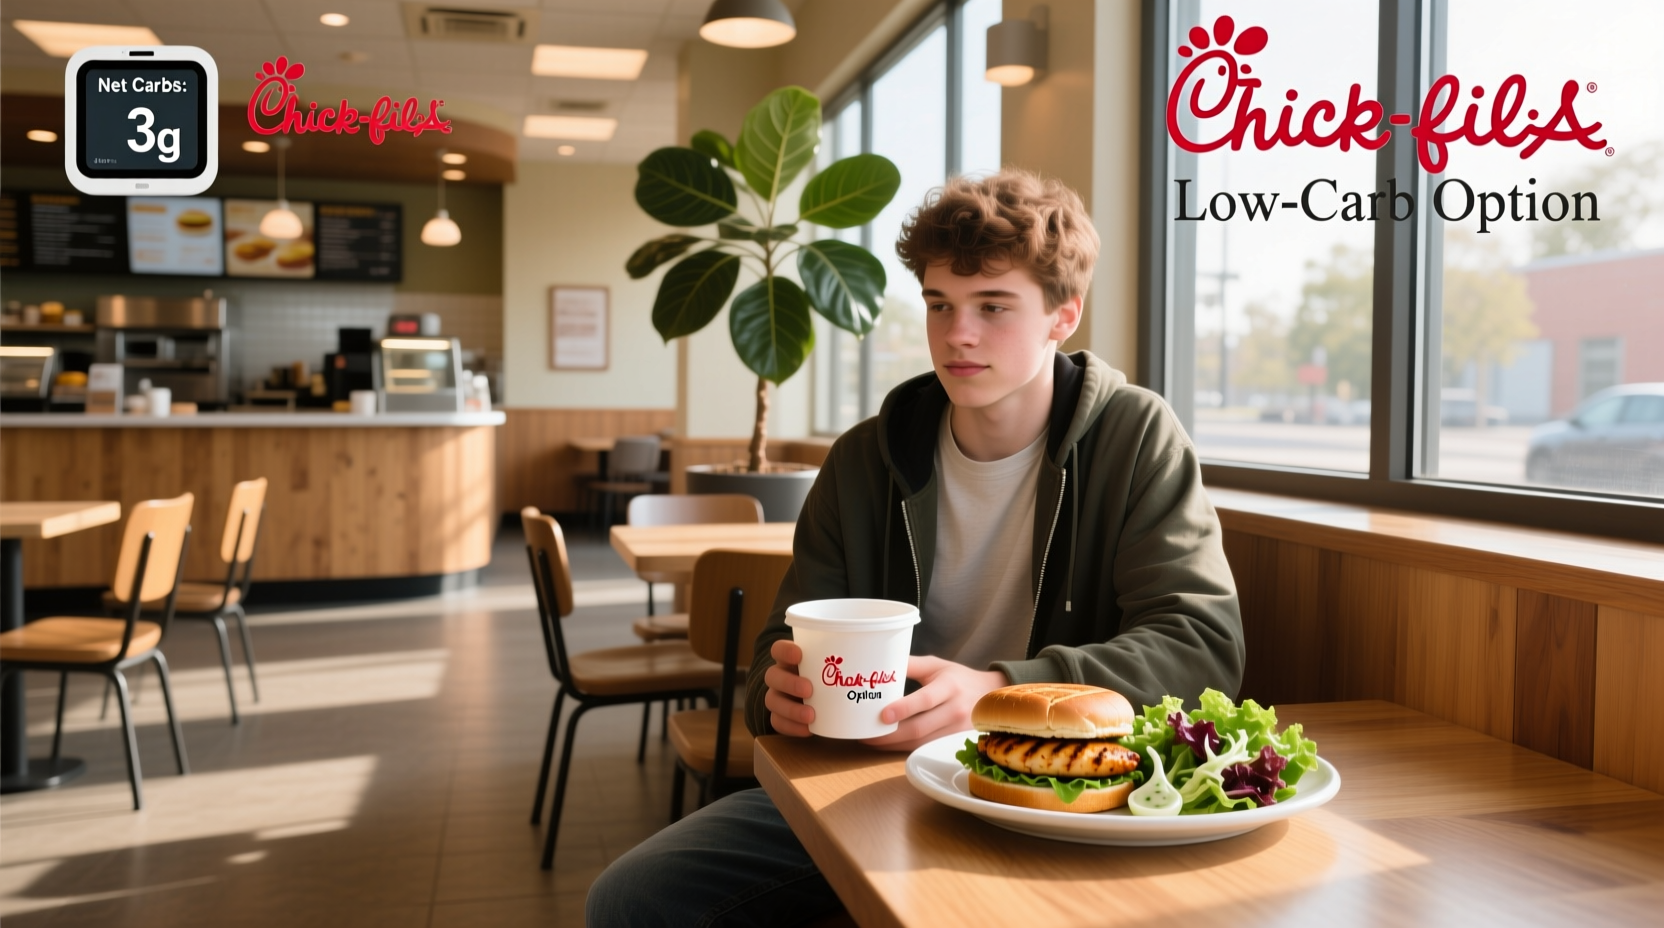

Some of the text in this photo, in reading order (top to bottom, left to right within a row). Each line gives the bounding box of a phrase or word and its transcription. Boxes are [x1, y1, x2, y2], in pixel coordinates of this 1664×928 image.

[98, 77, 187, 93] Net Carbs:
[127, 106, 181, 164] 3g
